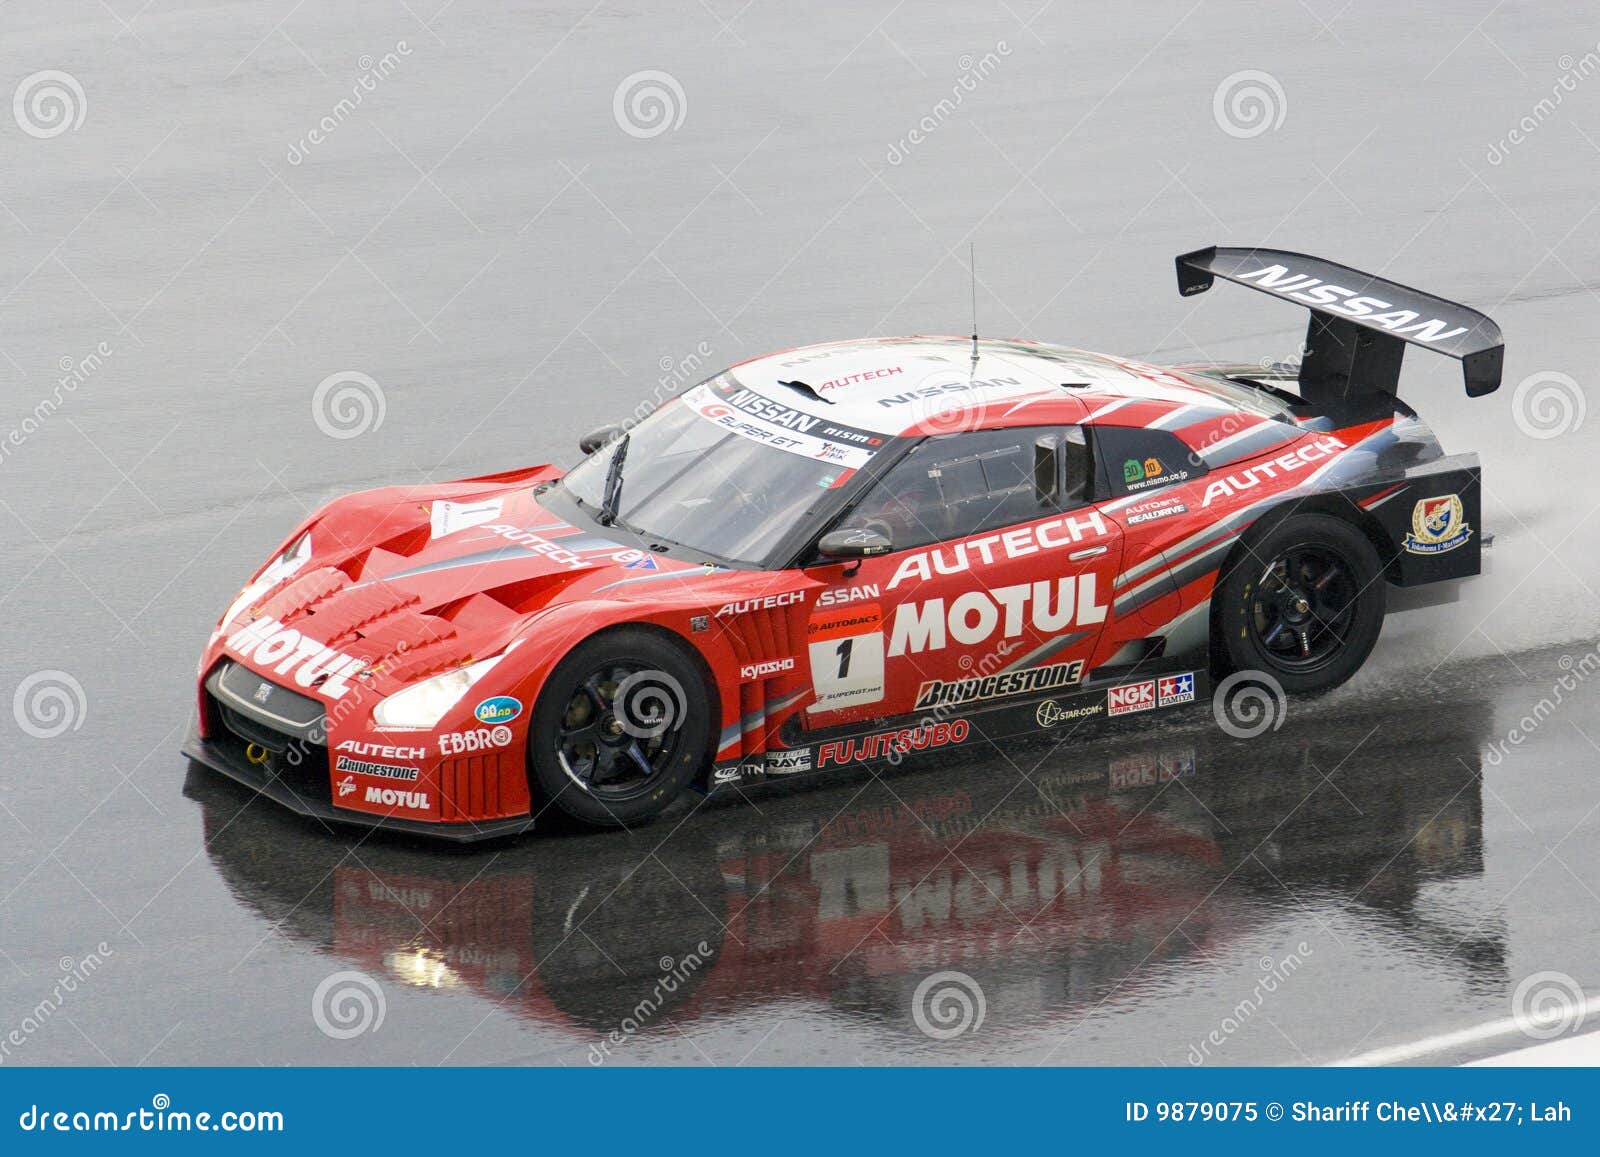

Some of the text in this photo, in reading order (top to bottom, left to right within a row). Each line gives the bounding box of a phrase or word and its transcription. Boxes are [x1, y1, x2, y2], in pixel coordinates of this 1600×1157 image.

[1237, 263, 1469, 343] NISSAN
[819, 366, 903, 392] AUTECH
[878, 376, 1020, 408] NISSAN
[726, 389, 821, 433] NISSAN
[718, 415, 804, 448] SUPER GT
[823, 427, 883, 446] nismo
[1127, 470, 1188, 491] www.nismo.co.jp
[1146, 463, 1156, 473] 10
[1202, 436, 1348, 508] AUTECH
[480, 524, 592, 570] AUTECH
[885, 511, 1108, 591] AUTECH
[715, 590, 805, 618] AUTECH
[887, 572, 1109, 658] MOTUL
[819, 615, 878, 631] AUTOBACS
[225, 615, 366, 700] MOTUL
[740, 658, 794, 680] KYOSHO
[836, 639, 854, 679] 1
[916, 660, 1083, 710] BRIDGESTONE
[1110, 684, 1153, 708] NGK
[1110, 702, 1153, 715] SPARK PLUGS
[1159, 693, 1193, 705] TAMIYA
[1060, 704, 1103, 721] STAR-CCM+
[335, 740, 425, 759] AUTECH
[817, 719, 969, 768] FUJITSUBO
[338, 757, 418, 780] BRIDGESTONE
[767, 755, 811, 769] RAYS
[365, 786, 430, 809] MOTUL
